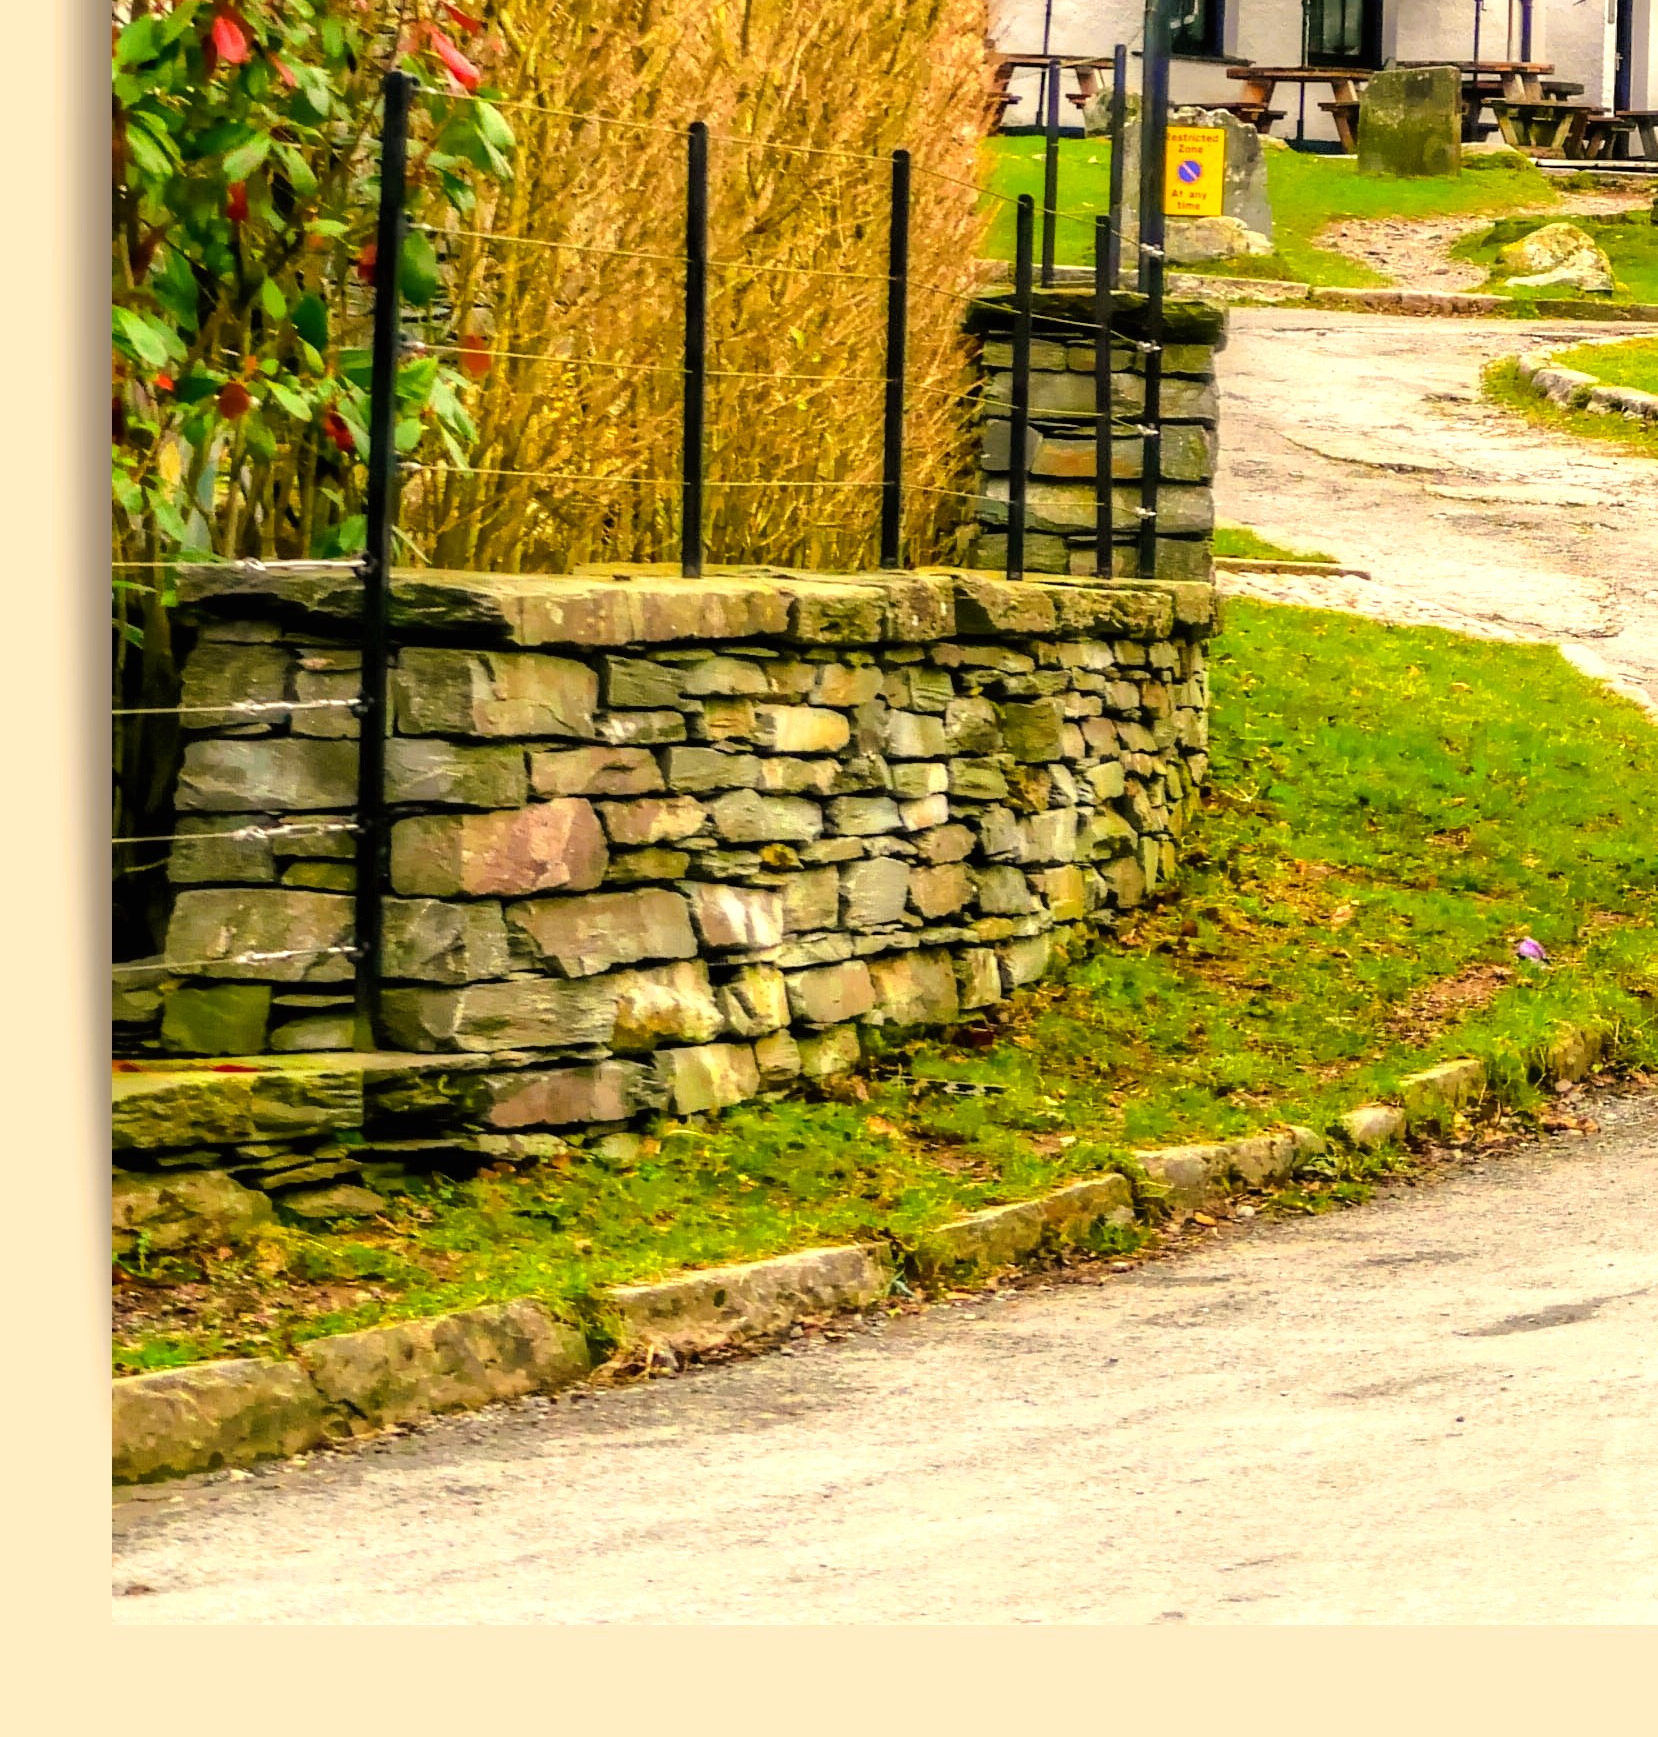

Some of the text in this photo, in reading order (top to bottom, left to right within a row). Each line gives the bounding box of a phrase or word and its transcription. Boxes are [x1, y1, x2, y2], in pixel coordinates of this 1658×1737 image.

[1178, 144, 1204, 154] Zone
[1172, 189, 1207, 200] At any
[1177, 201, 1202, 211] time
